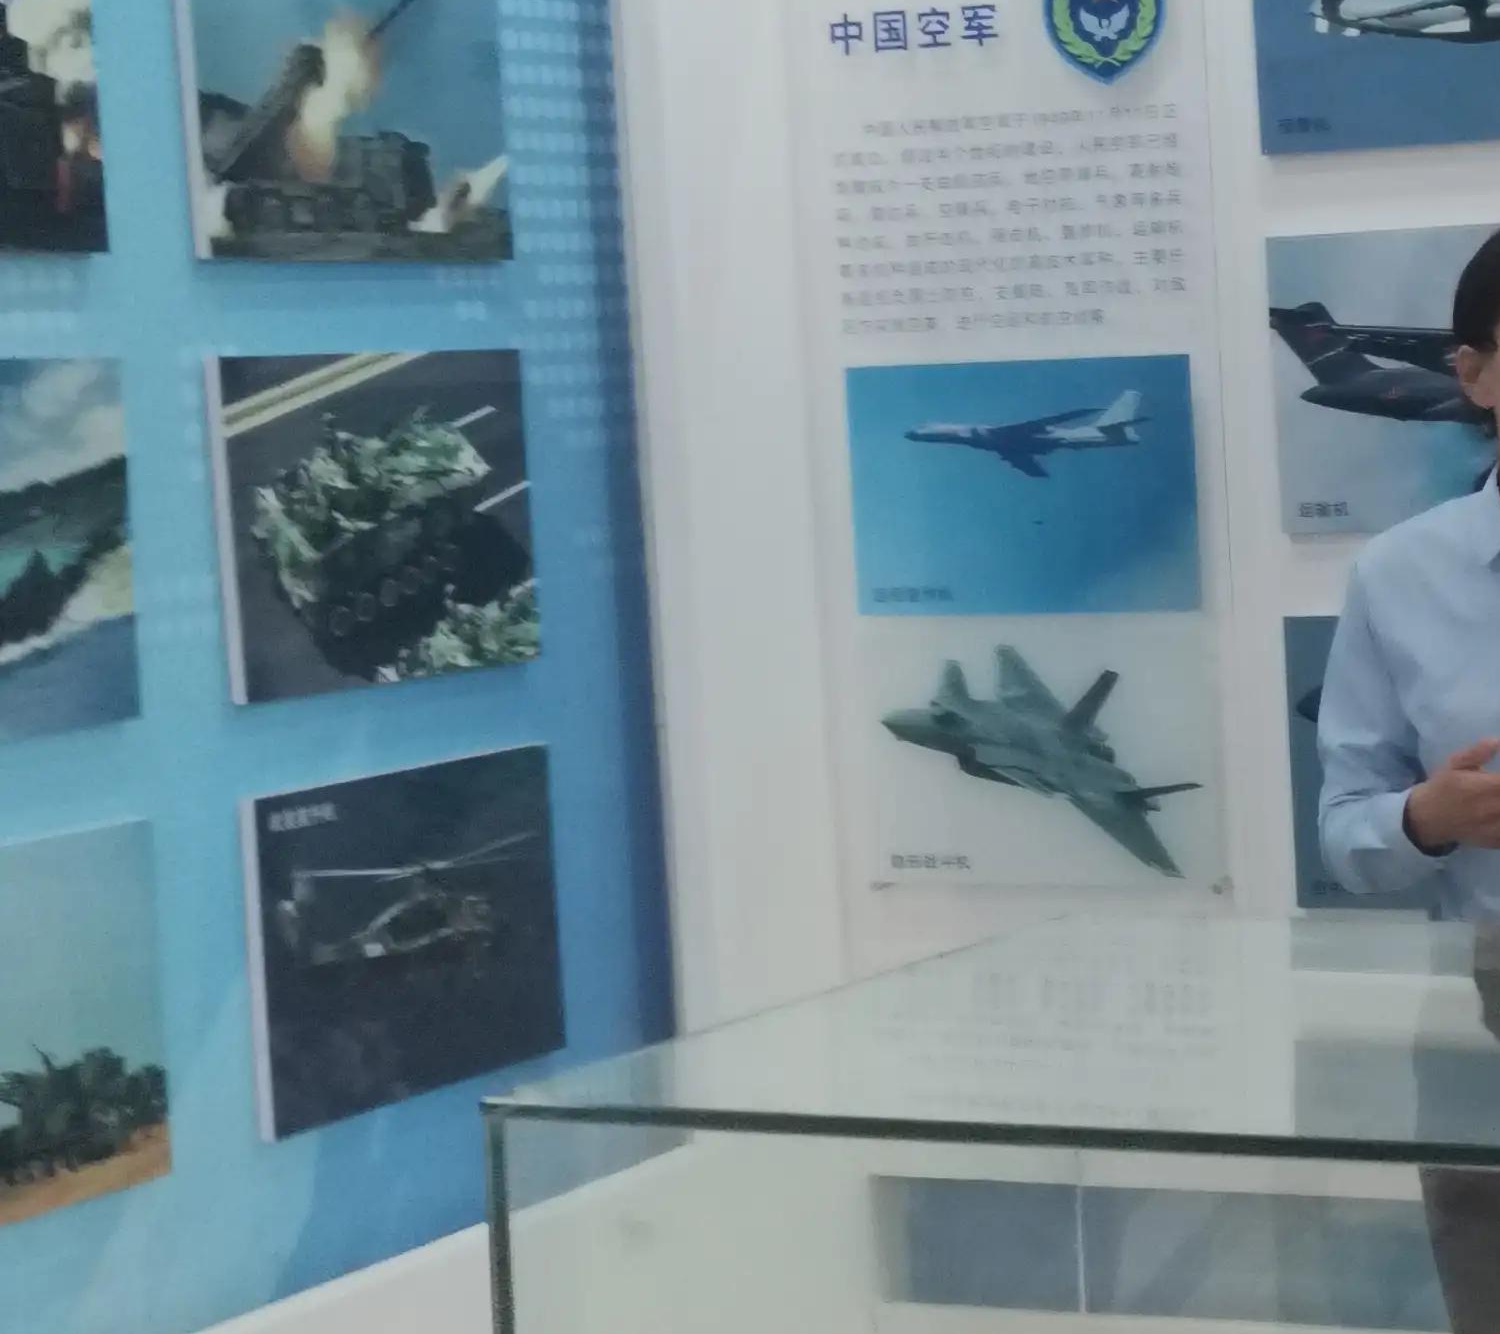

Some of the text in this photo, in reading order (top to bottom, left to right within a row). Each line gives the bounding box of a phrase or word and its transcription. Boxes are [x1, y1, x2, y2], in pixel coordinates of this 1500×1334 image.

[829, 4, 999, 56] 中国空军
[1298, 501, 1349, 519] 运输机
